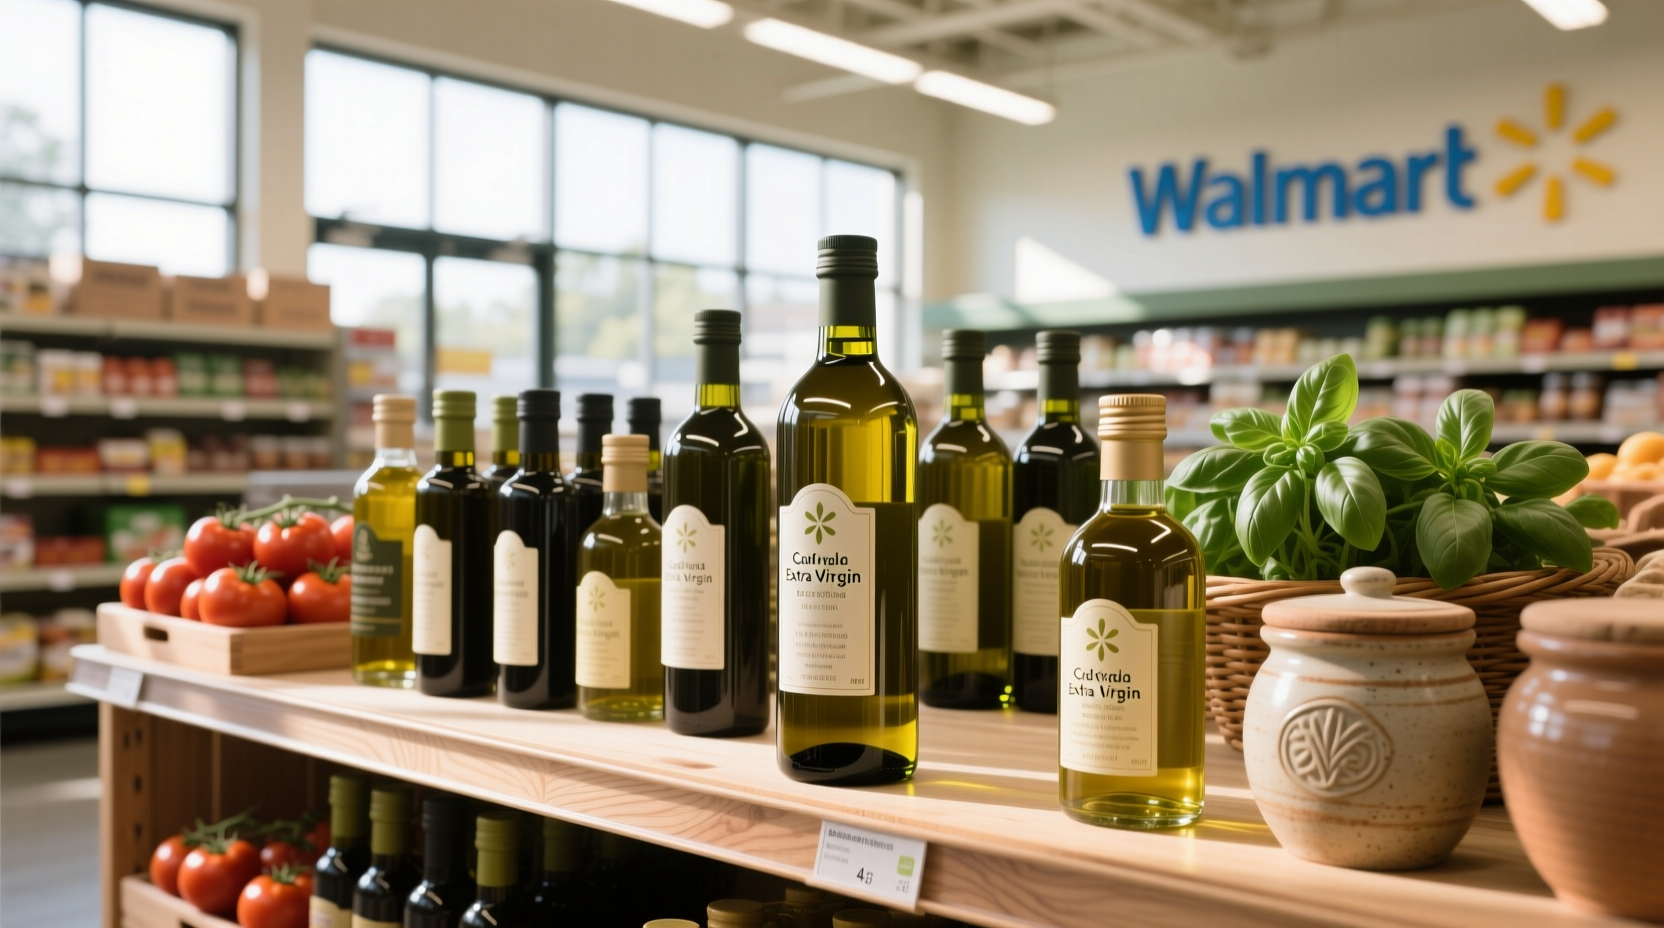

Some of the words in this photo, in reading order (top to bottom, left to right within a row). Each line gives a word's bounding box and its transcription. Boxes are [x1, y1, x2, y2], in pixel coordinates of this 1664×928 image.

[1129, 124, 1478, 236] Walmart
[786, 568, 812, 582] Extra
[815, 569, 861, 588] Virgin
[1100, 685, 1141, 704] Virgin
